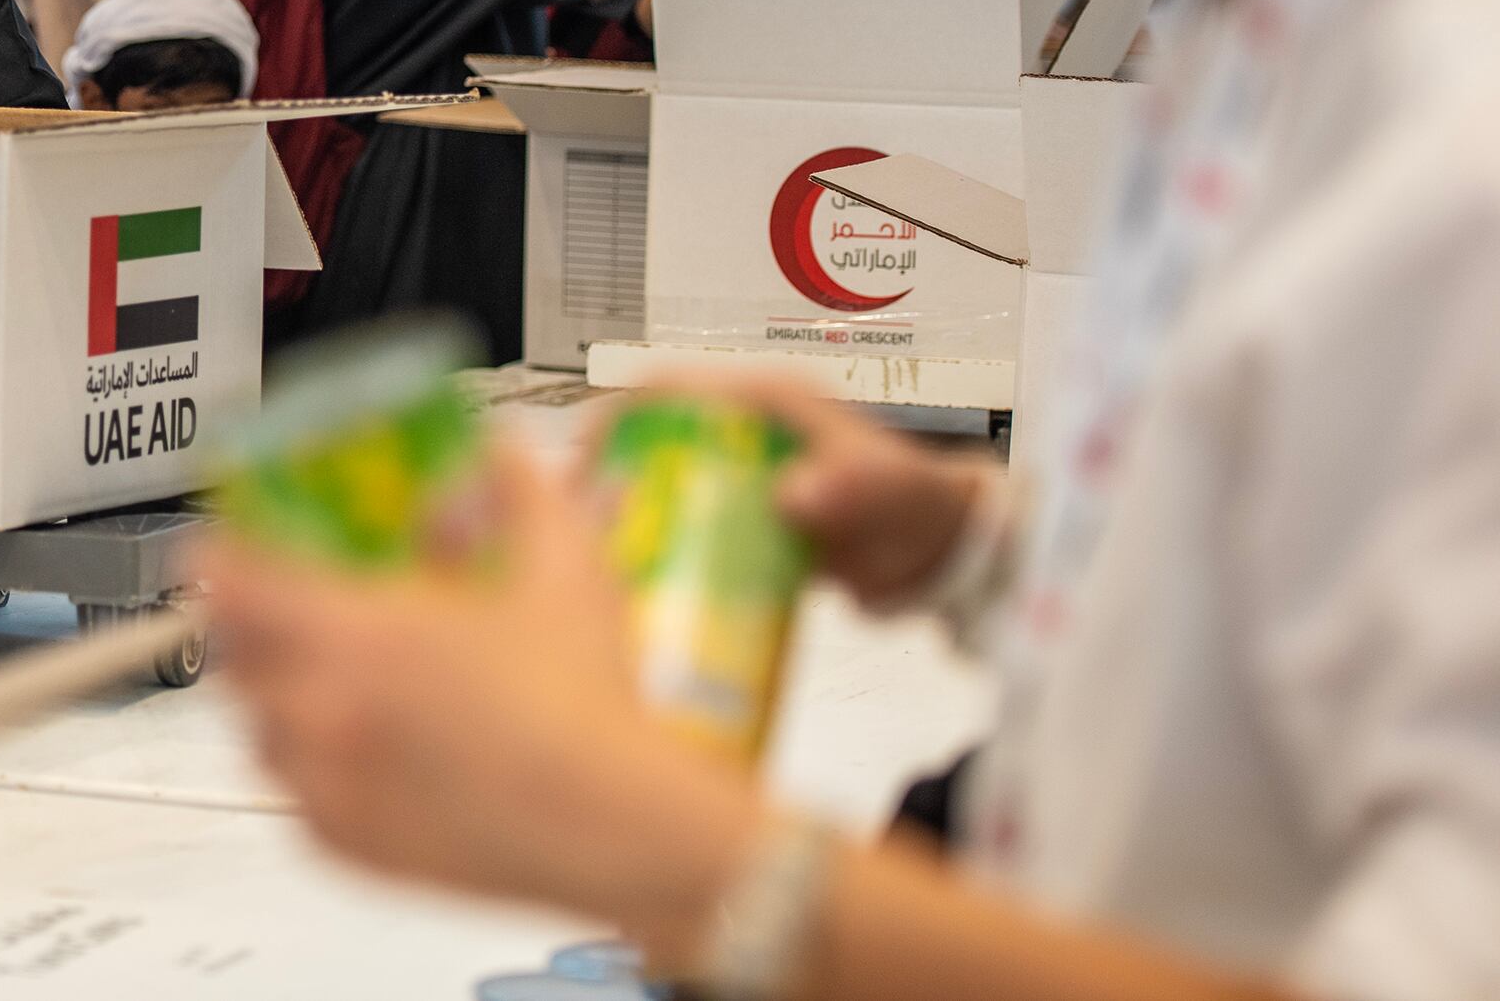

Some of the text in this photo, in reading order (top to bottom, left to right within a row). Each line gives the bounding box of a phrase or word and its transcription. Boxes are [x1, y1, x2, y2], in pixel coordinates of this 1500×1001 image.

[830, 247, 918, 275] الإماراتي
[765, 326, 914, 346] EMIRATES RED CRESCENT
[85, 350, 199, 403] المساعدات الإماراتية
[83, 396, 197, 467] UAE AID
